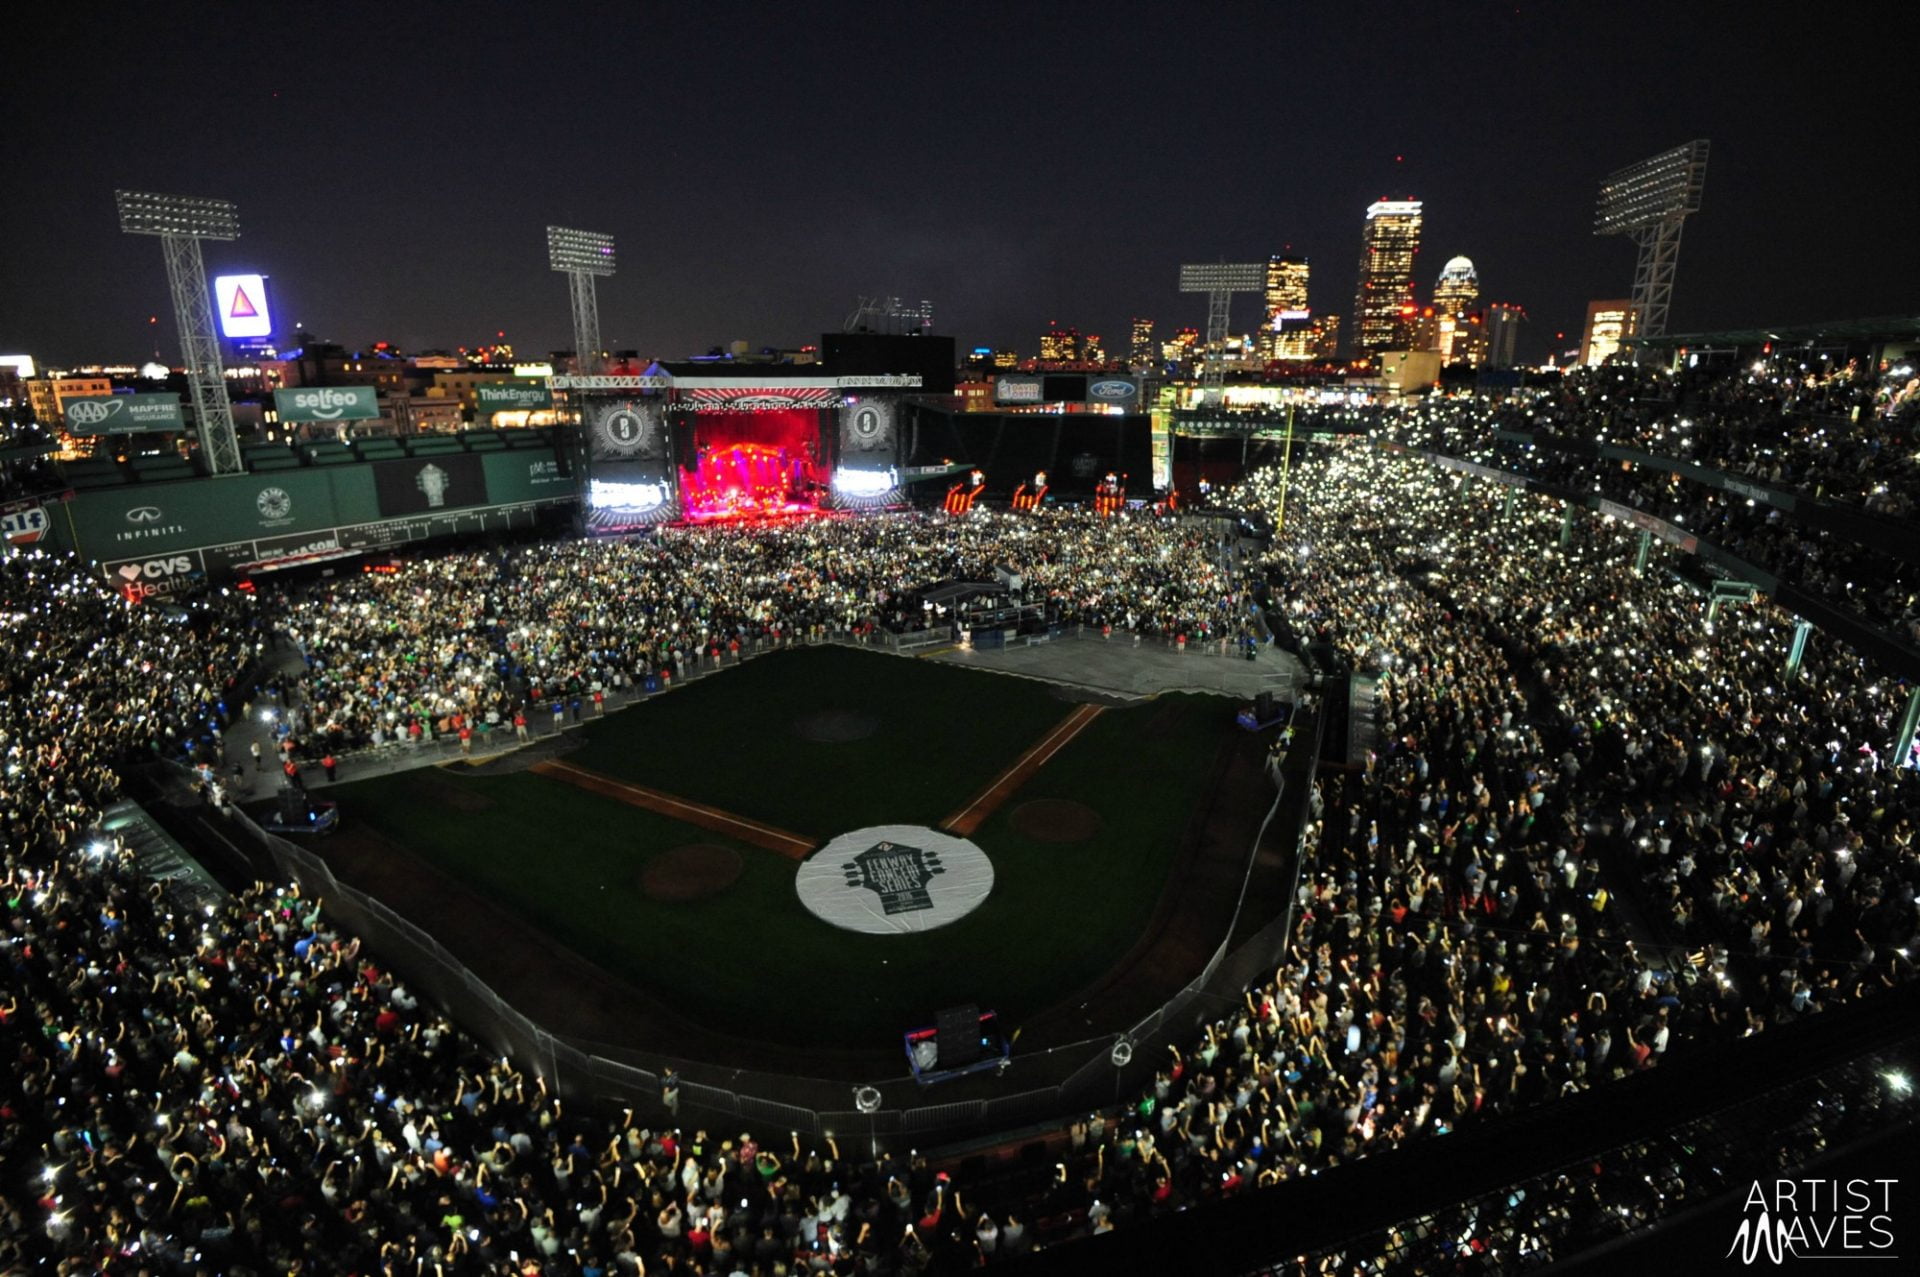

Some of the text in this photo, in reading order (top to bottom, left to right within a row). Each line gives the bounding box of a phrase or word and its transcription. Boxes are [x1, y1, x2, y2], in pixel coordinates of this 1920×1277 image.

[1100, 383, 1125, 395] Ford
[73, 401, 103, 421] AAA
[129, 404, 177, 413] MAPFRE
[116, 525, 183, 541] INFINITI
[143, 556, 192, 578] CVS
[879, 876, 922, 894] SERIES
